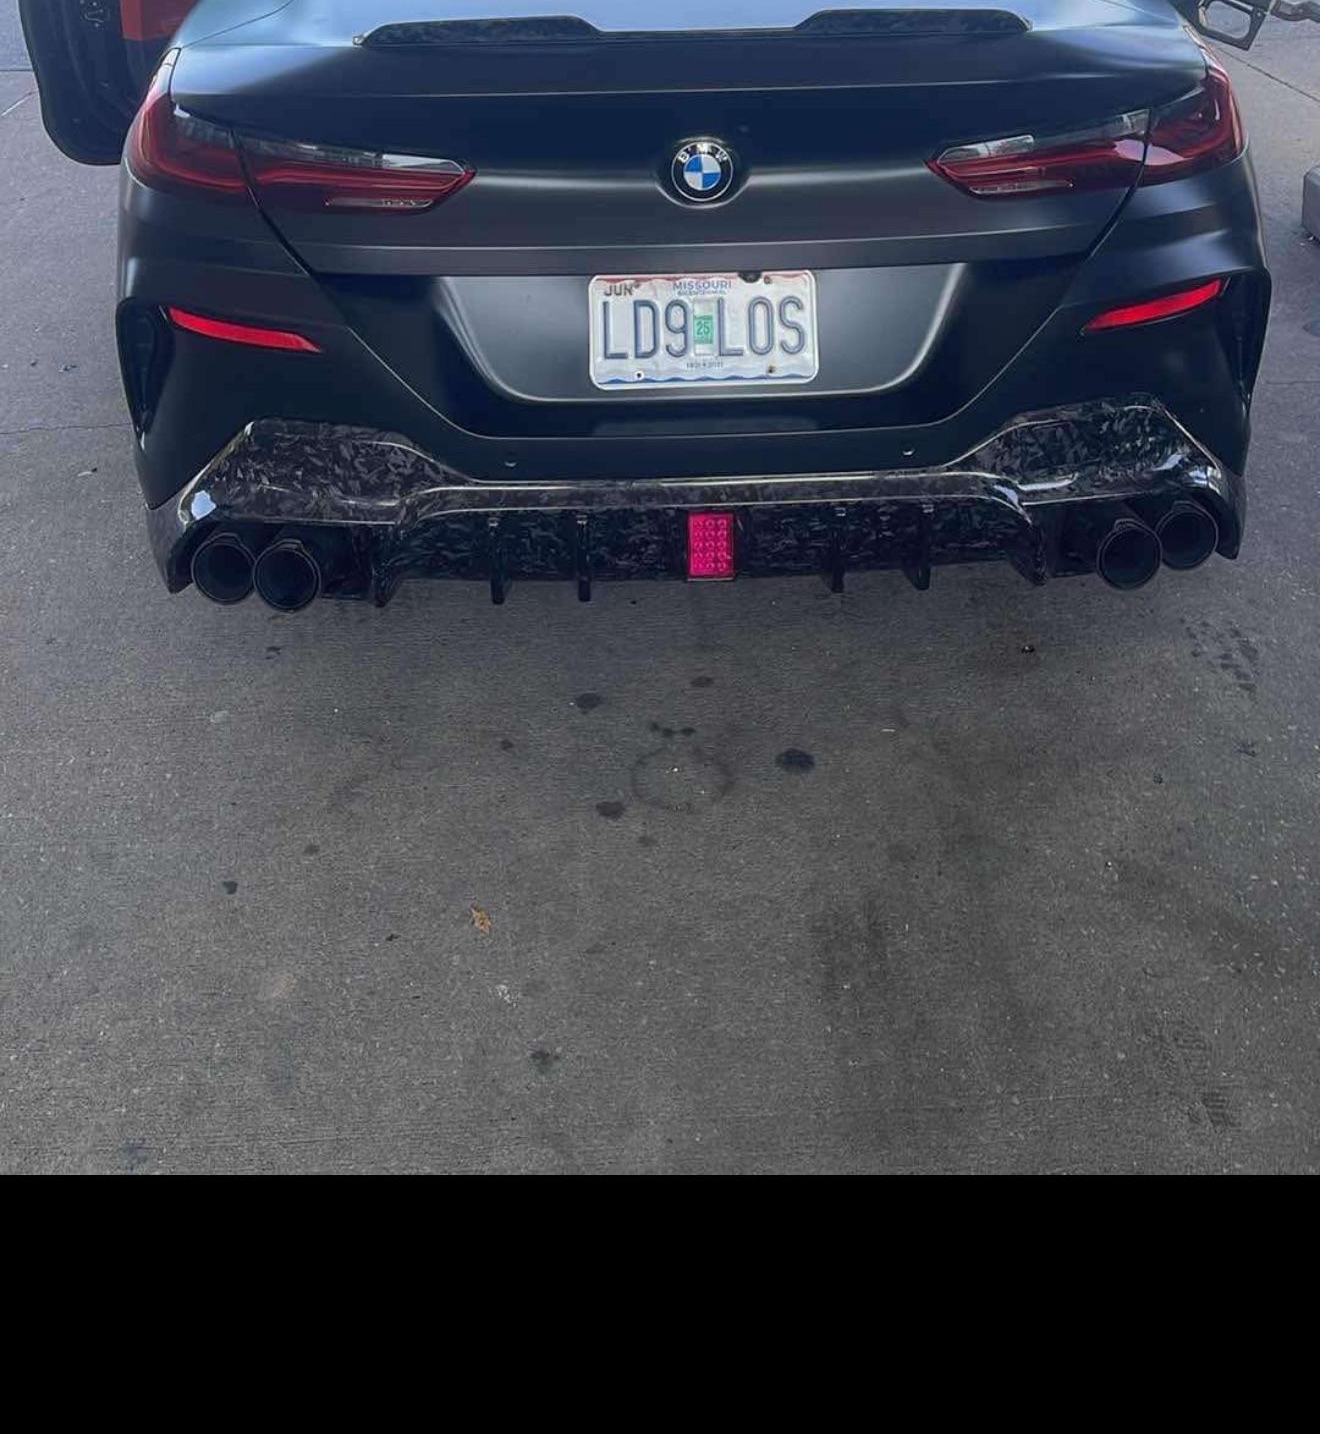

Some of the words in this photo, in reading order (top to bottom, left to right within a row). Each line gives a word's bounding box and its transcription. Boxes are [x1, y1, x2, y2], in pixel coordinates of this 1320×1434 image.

[678, 143, 728, 163] BMW
[604, 283, 633, 296] JUN
[673, 279, 732, 291] MISSOURI
[603, 299, 688, 359] LD9
[696, 320, 710, 335] 25
